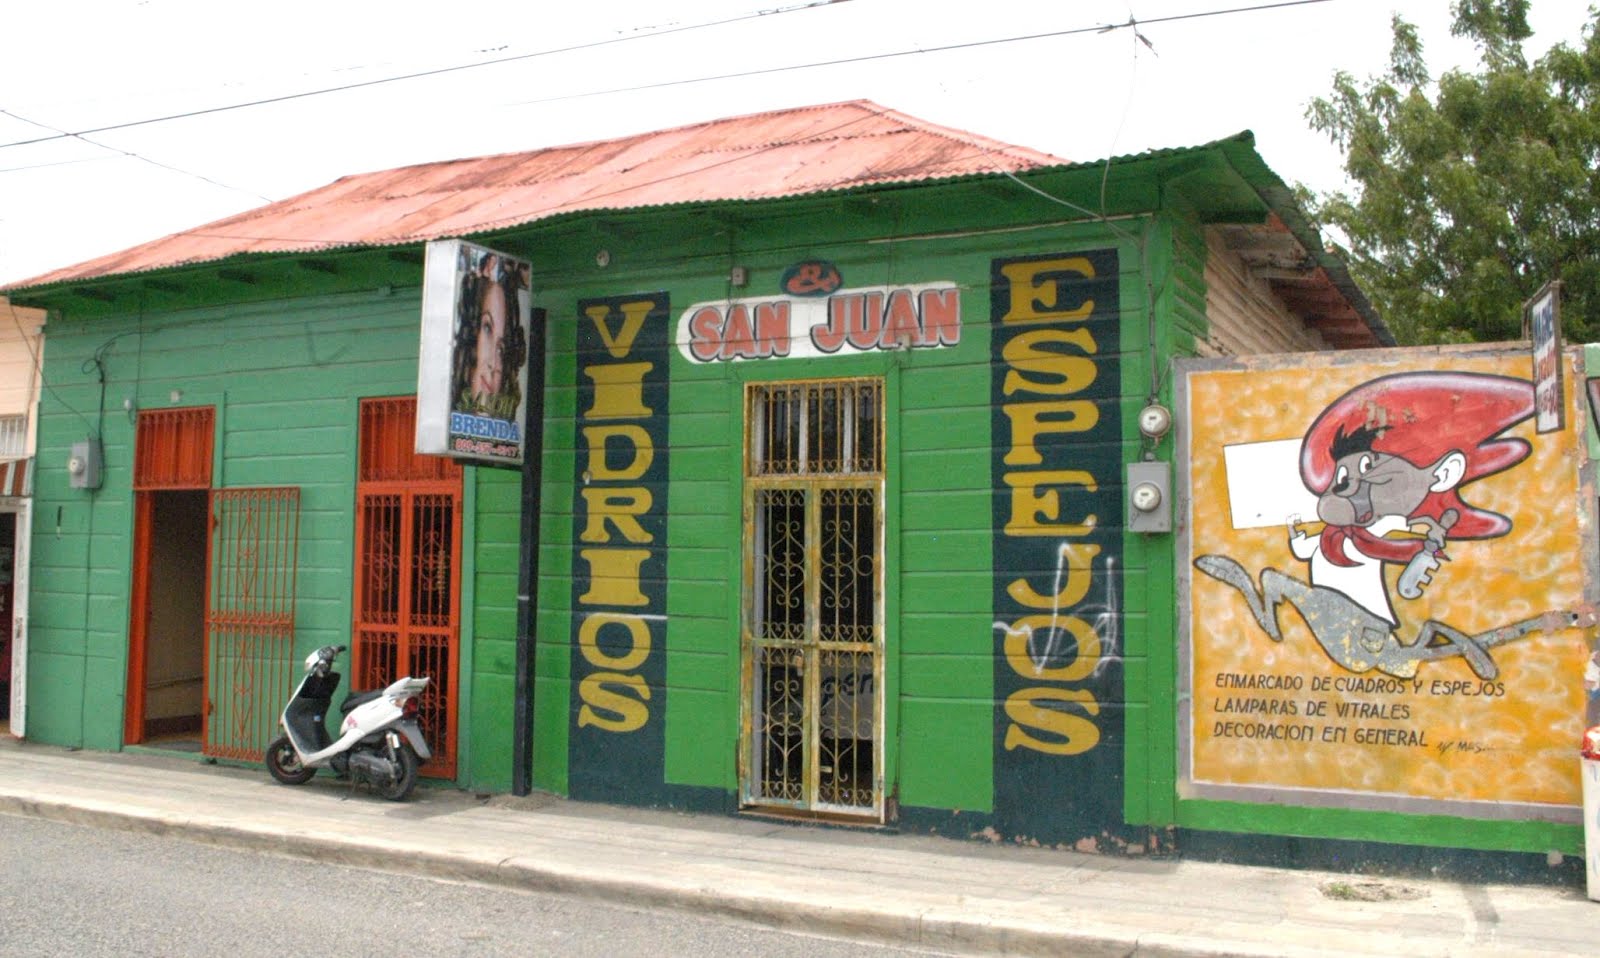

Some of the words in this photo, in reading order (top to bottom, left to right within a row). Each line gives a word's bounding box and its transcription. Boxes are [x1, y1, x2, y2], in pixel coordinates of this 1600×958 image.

[689, 301, 792, 361] SAN
[810, 288, 961, 353] JUAN
[451, 412, 520, 442] BRENDA
[578, 301, 655, 732] VIDRIOS
[1001, 256, 1101, 756] ESPEJOS
[1215, 673, 1303, 691] ENMARCADO
[1311, 676, 1334, 692] DE
[1335, 677, 1405, 694] CUADROS
[1413, 680, 1423, 694] Y
[1430, 680, 1506, 697] ESPEJOS
[1214, 697, 1298, 715] LAMPARAS
[1306, 701, 1327, 717] DE
[1336, 702, 1411, 720] VITRALES
[1213, 722, 1314, 741] DECORACION
[1322, 726, 1347, 743] EN
[1354, 728, 1429, 747] GENERAL
